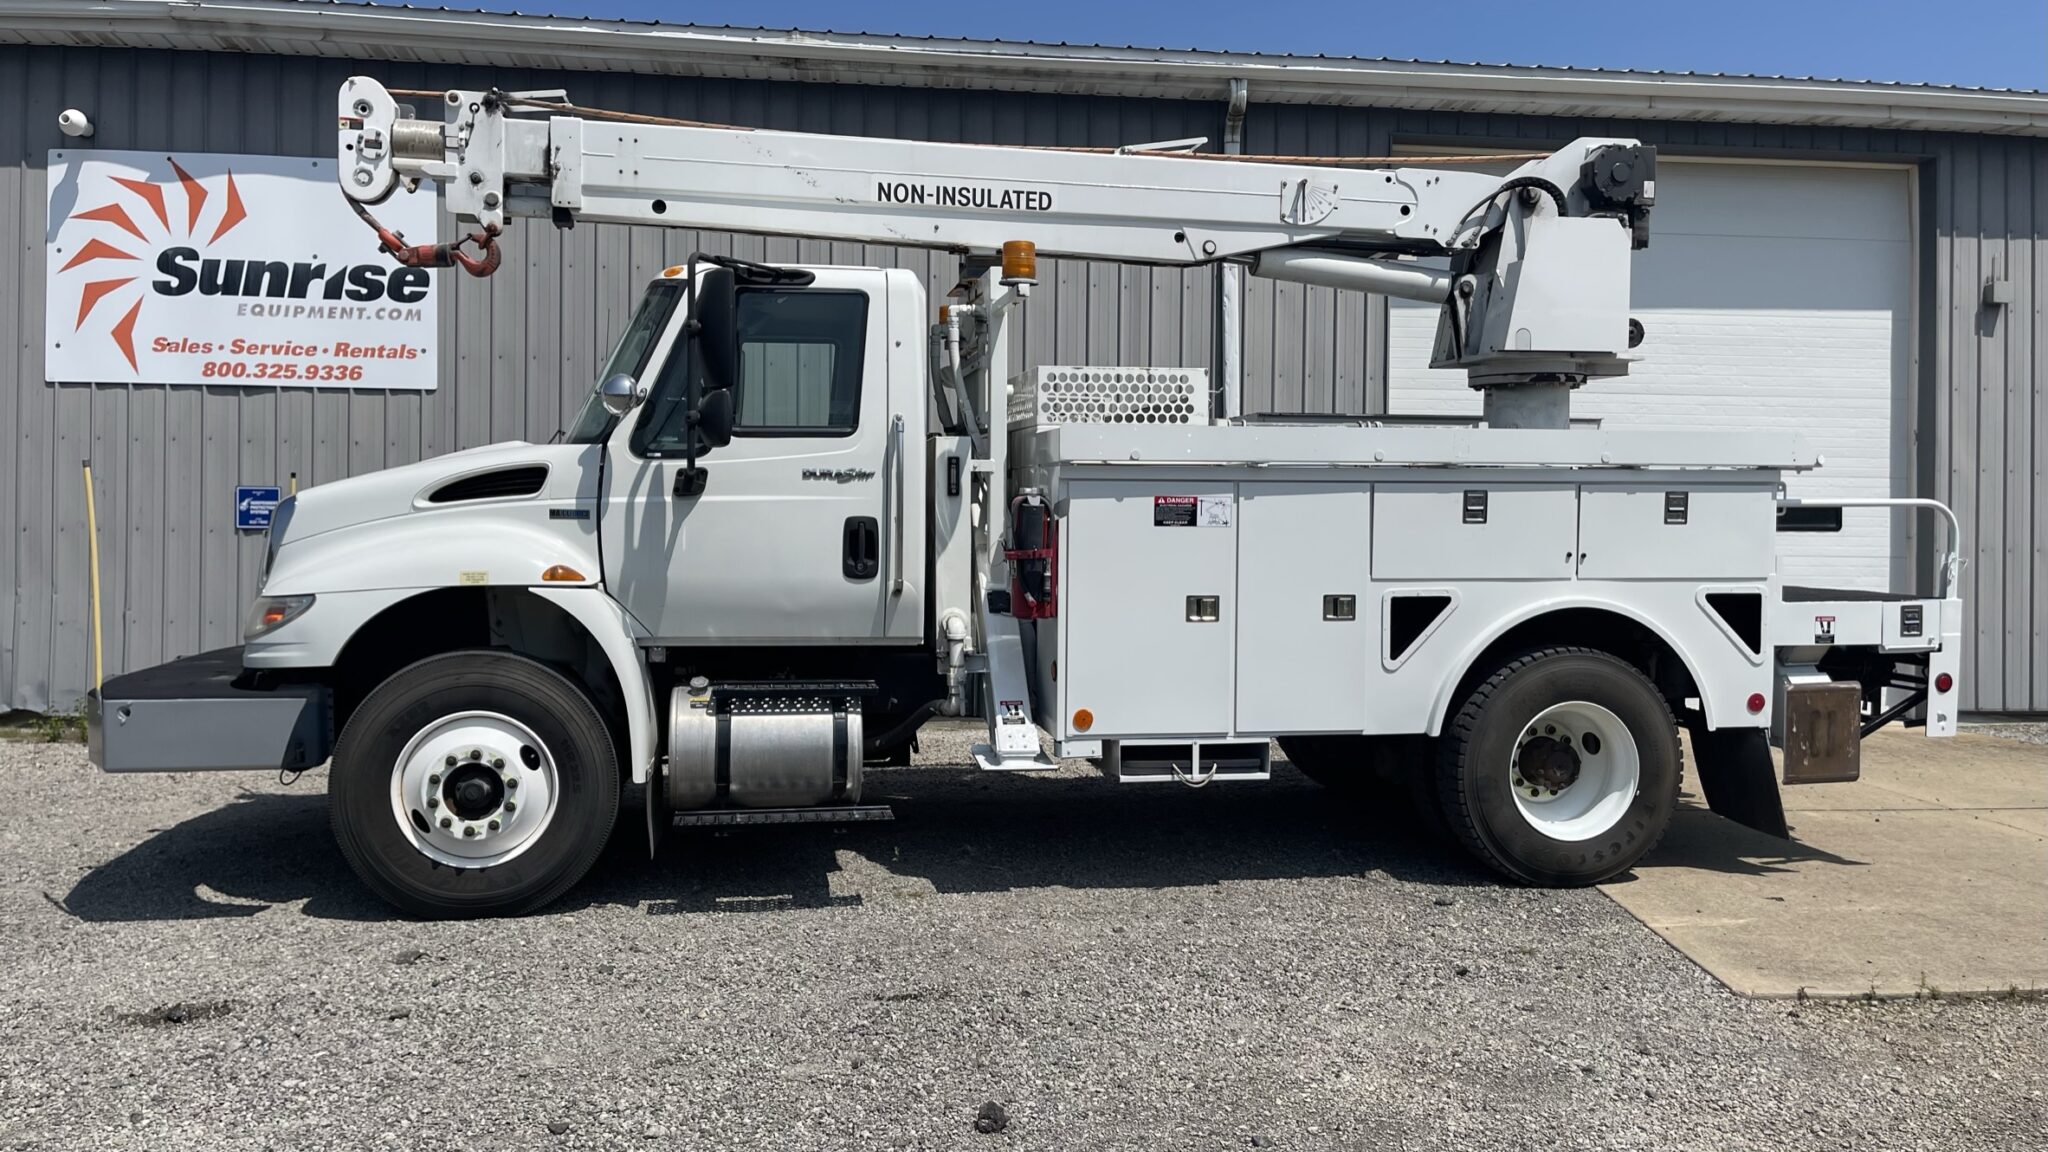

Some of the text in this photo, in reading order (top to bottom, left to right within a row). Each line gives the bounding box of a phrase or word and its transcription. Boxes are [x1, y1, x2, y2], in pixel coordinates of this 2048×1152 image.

[878, 182, 1052, 211] NON-INSULATED
[152, 246, 431, 303] Sunrise
[237, 303, 422, 322] EQUIPMENT.COM
[152, 336, 418, 360] Sales Service Rentals
[202, 361, 363, 382] 800.325.9336
